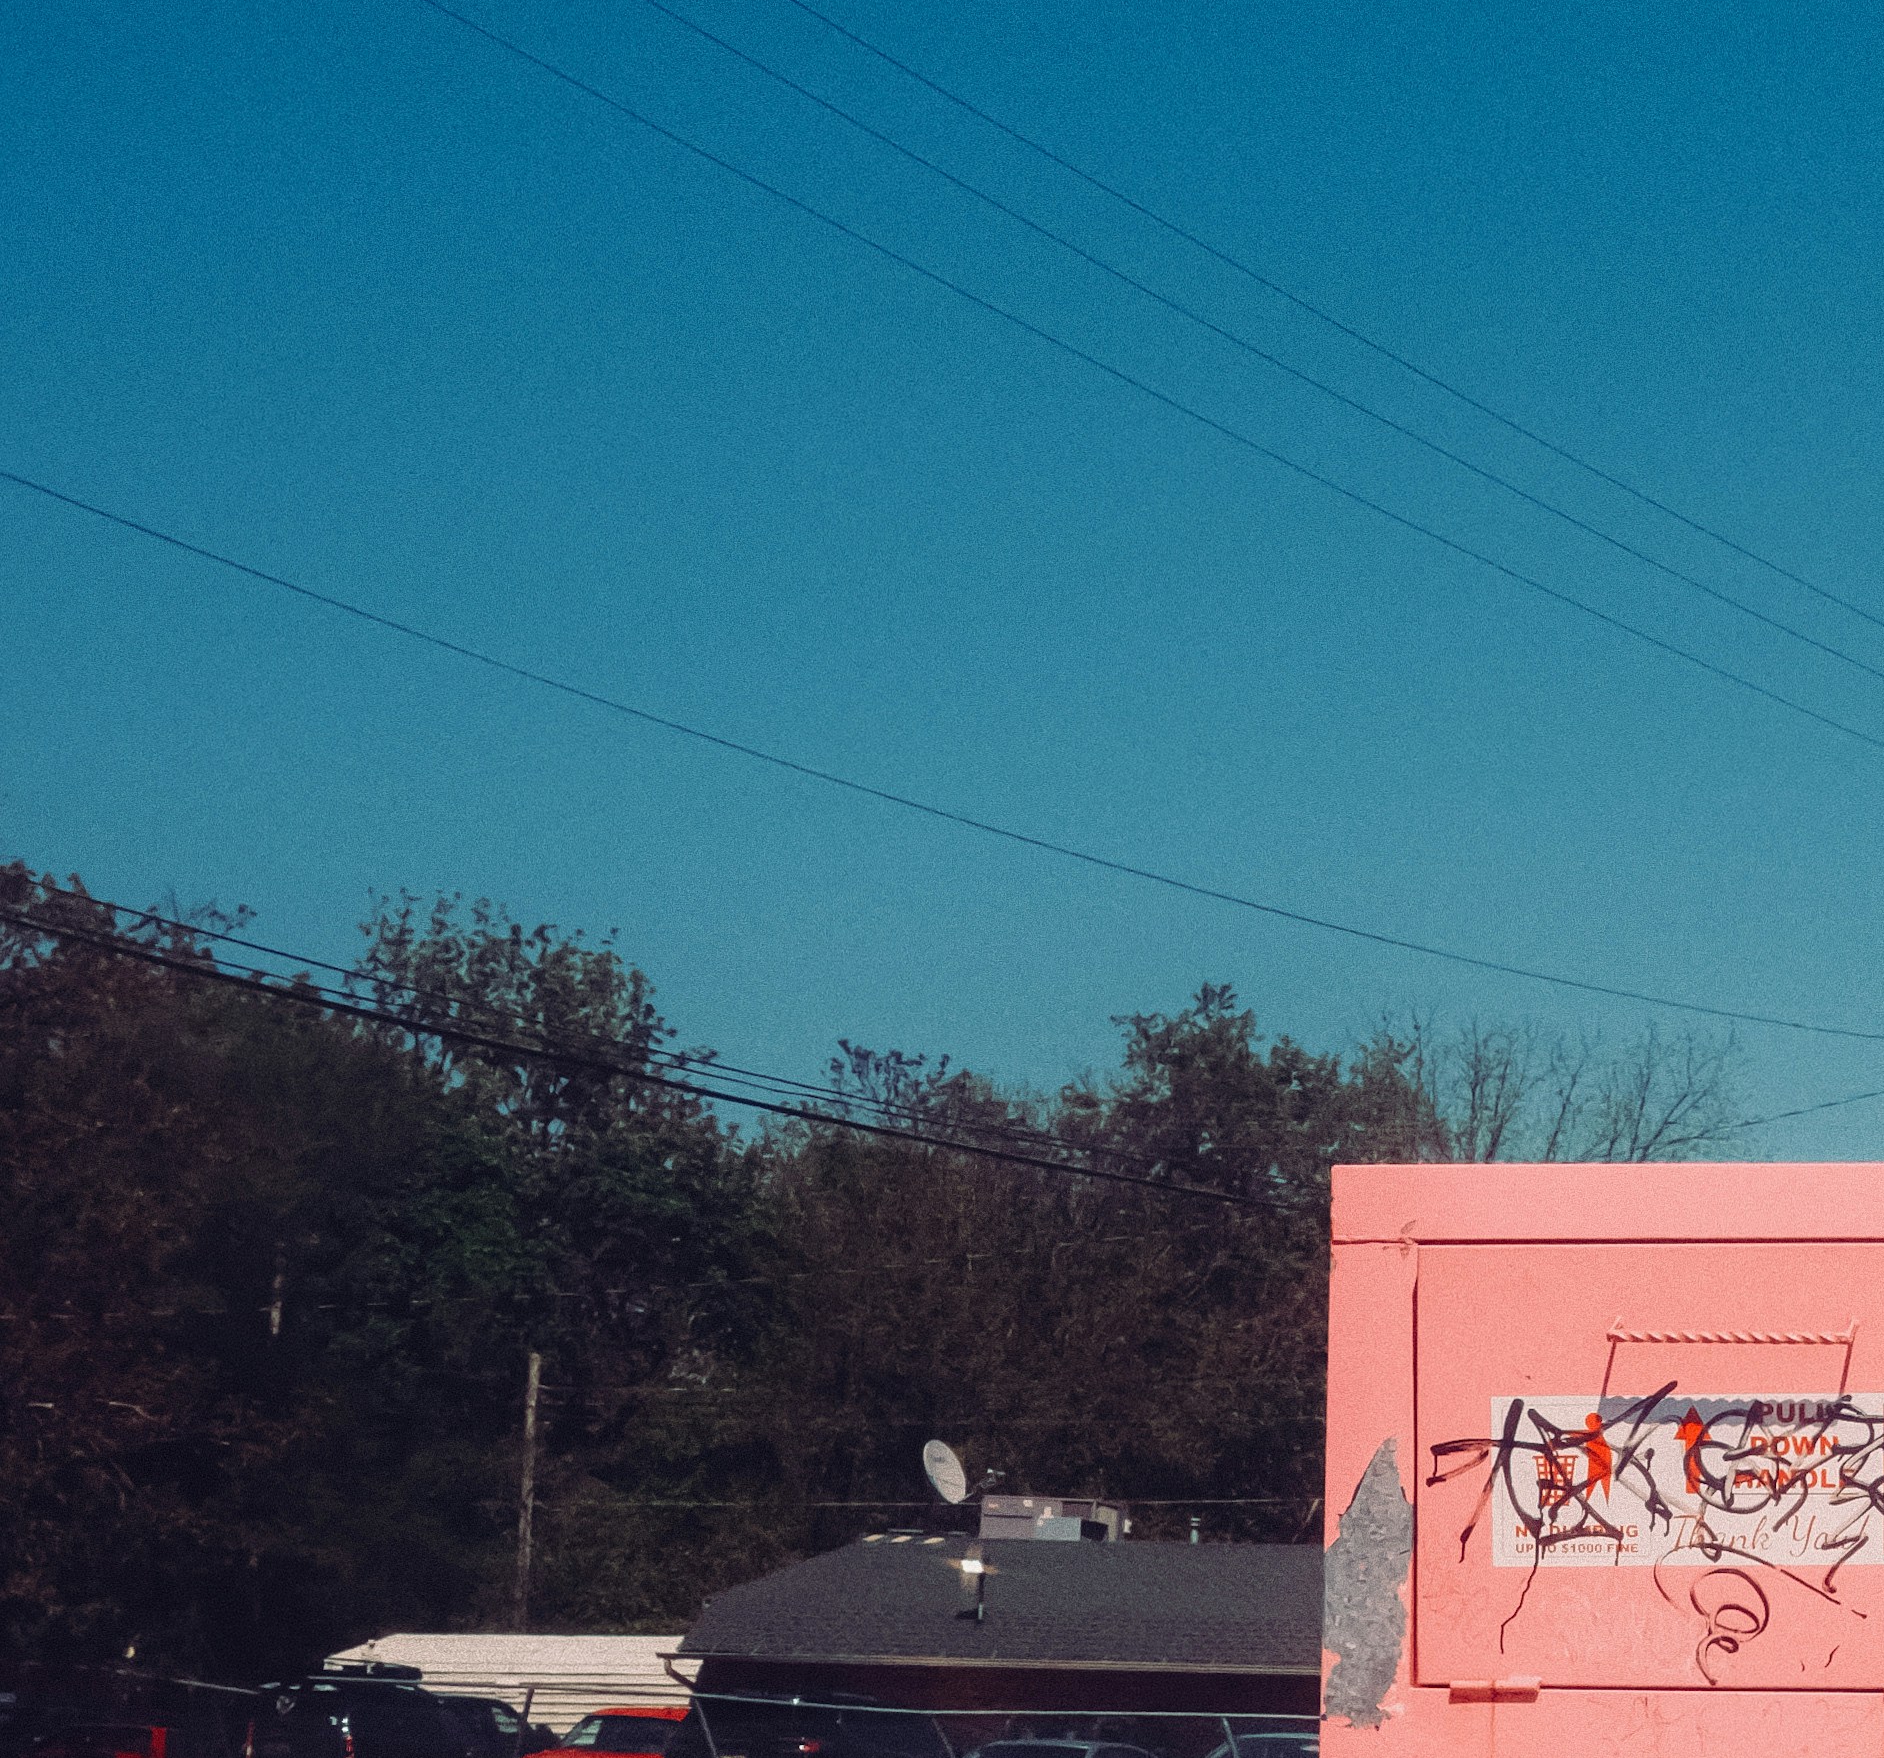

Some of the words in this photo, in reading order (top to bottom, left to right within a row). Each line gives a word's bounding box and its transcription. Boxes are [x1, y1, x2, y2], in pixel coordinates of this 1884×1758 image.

[1757, 1403, 1833, 1424] PULL
[1750, 1436, 1839, 1456] DOWN
[1516, 1525, 1538, 1538] N
[1516, 1543, 1534, 1554] UP
[1561, 1543, 1602, 1554] $1000
[1607, 1543, 1639, 1554] FINE
